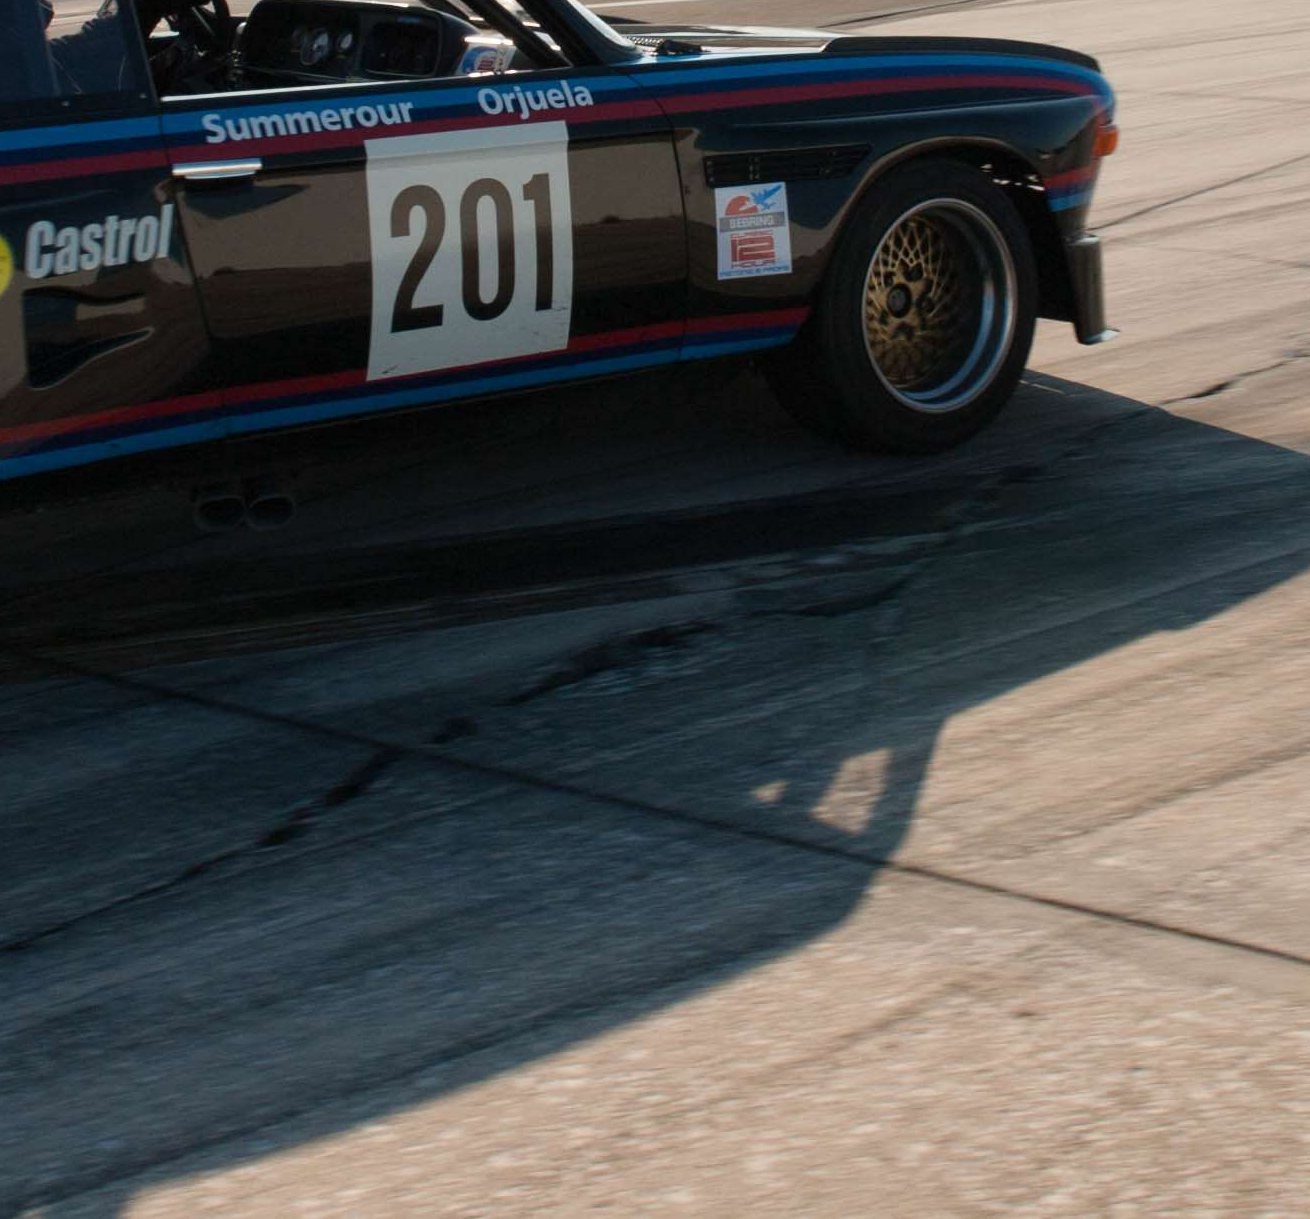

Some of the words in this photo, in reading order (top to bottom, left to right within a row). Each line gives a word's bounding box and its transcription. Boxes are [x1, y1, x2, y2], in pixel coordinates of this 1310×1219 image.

[202, 99, 414, 144] Summerour
[477, 79, 594, 120] Orjuela
[24, 203, 176, 279] Castrol
[391, 172, 553, 334] 201
